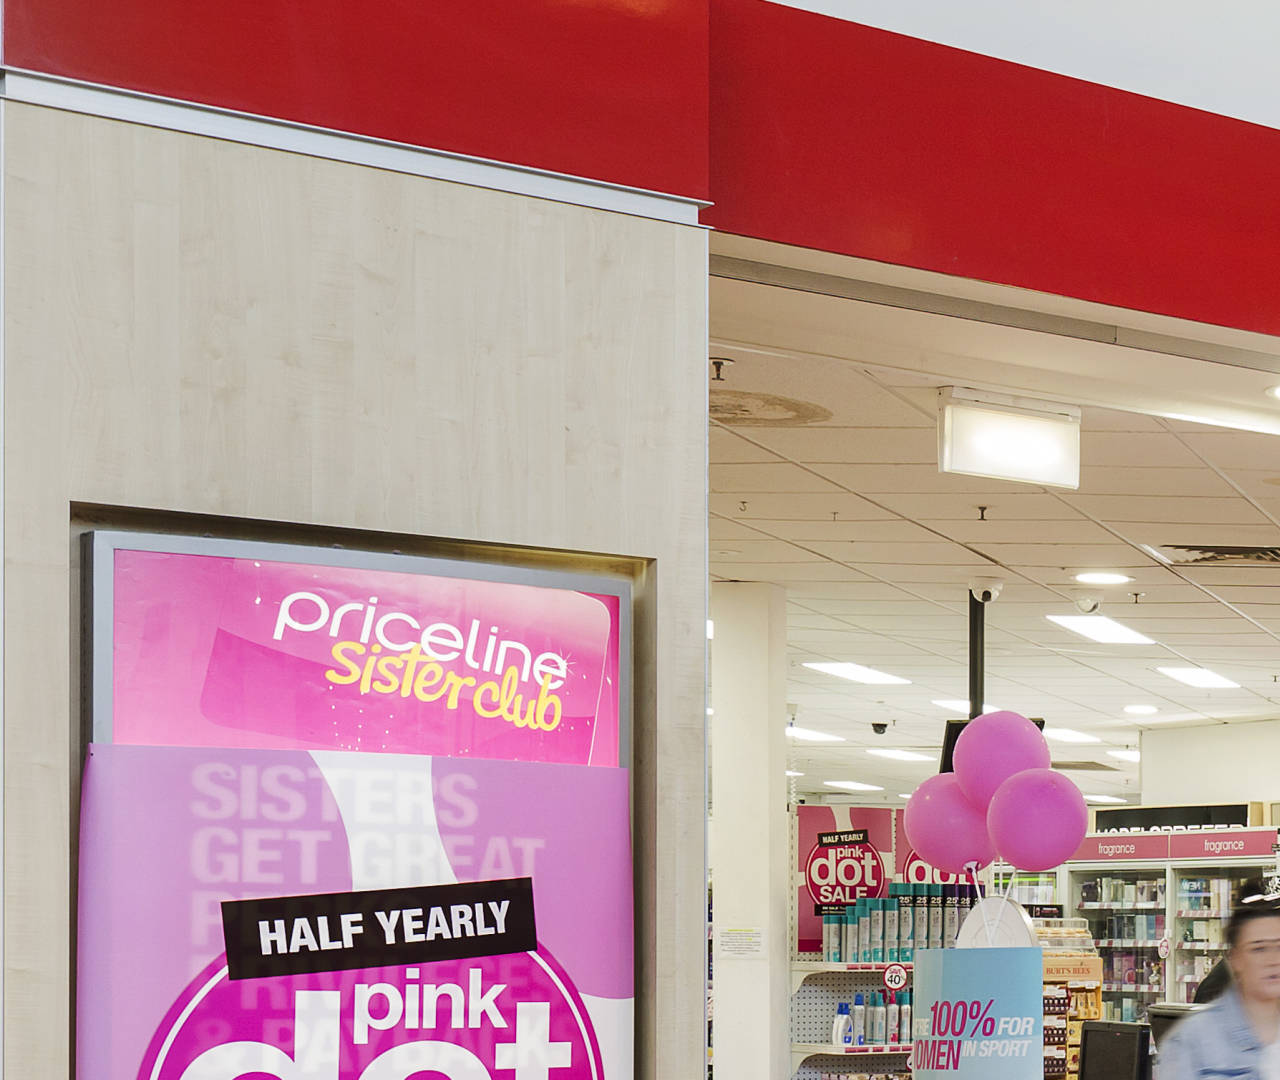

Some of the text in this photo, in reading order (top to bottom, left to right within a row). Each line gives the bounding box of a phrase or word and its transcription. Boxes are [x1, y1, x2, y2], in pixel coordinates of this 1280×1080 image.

[272, 591, 567, 690] priceline
[837, 845, 863, 859] pink
[1098, 843, 1135, 857] fragrance
[1204, 840, 1245, 853] fragrance
[811, 849, 877, 886] dot
[820, 886, 867, 903] SALE
[258, 913, 364, 955] HALF
[375, 900, 510, 944] YEARLY
[353, 968, 508, 1045] pink
[930, 1000, 996, 1038] 100%
[998, 1017, 1035, 1036] FOR
[914, 1039, 1033, 1071] OMEN IN SPORT
